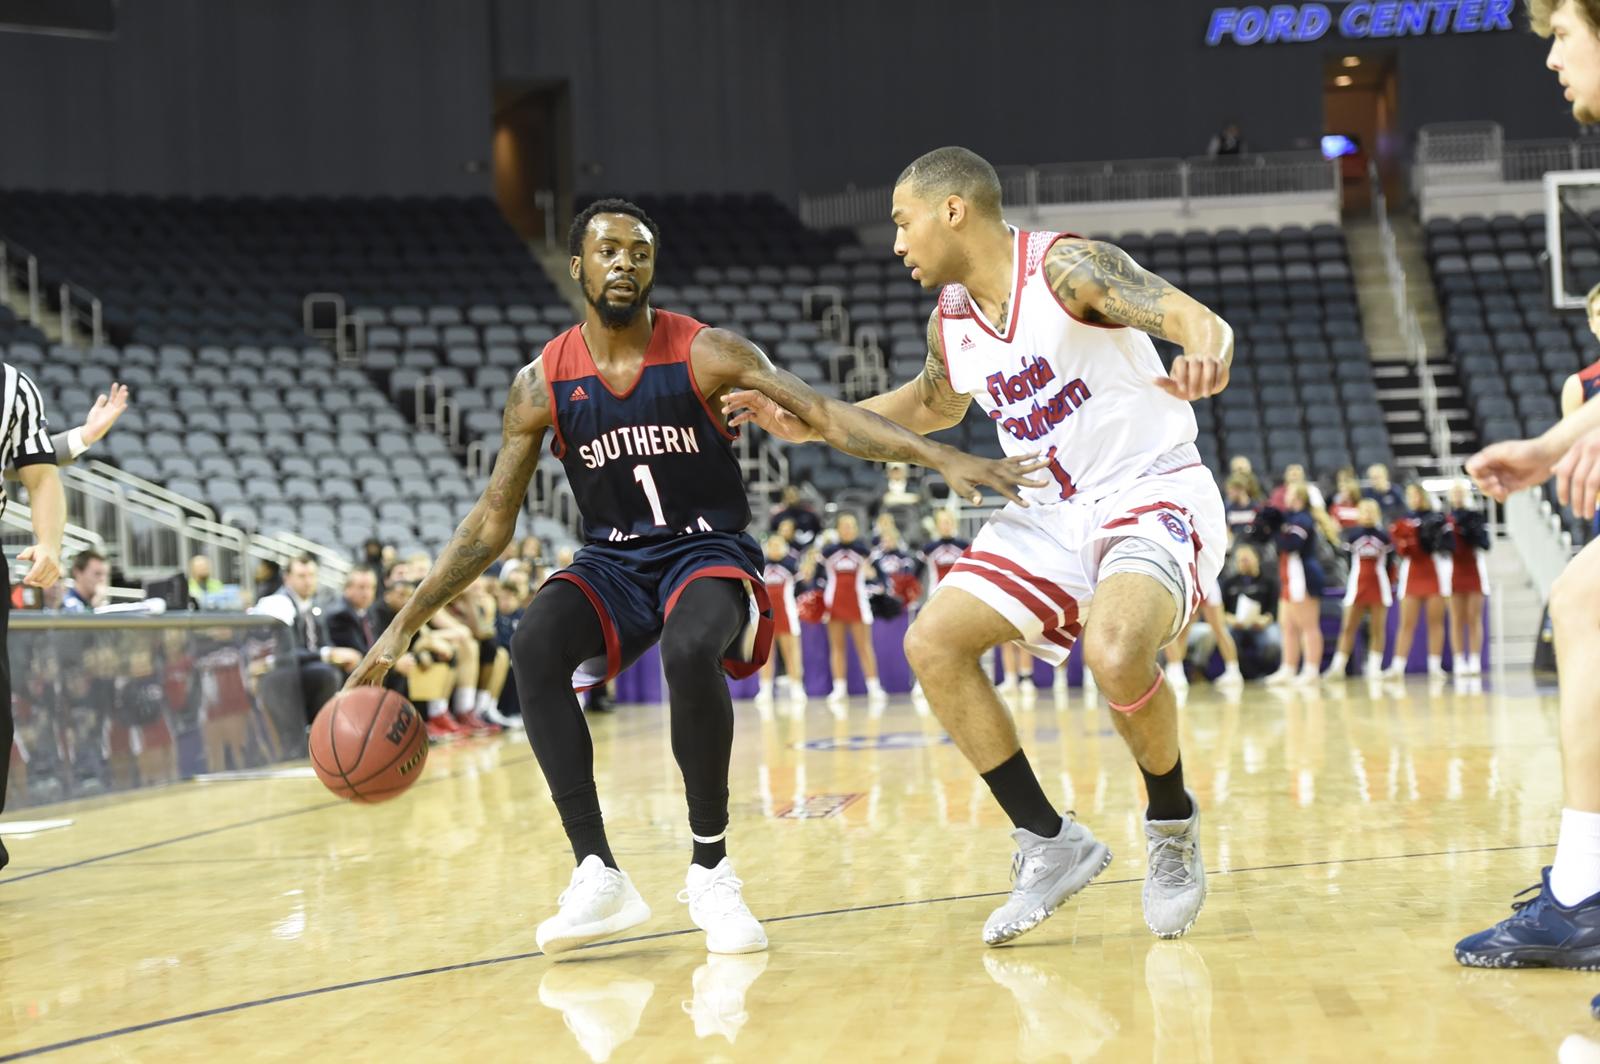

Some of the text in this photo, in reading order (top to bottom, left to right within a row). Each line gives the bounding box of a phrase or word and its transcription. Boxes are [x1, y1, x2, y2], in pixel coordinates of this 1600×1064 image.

[1205, 0, 1514, 46] FORD CENTER
[578, 425, 700, 469] SOUTHERN
[633, 464, 667, 526] 1
[1046, 445, 1077, 500] 1
